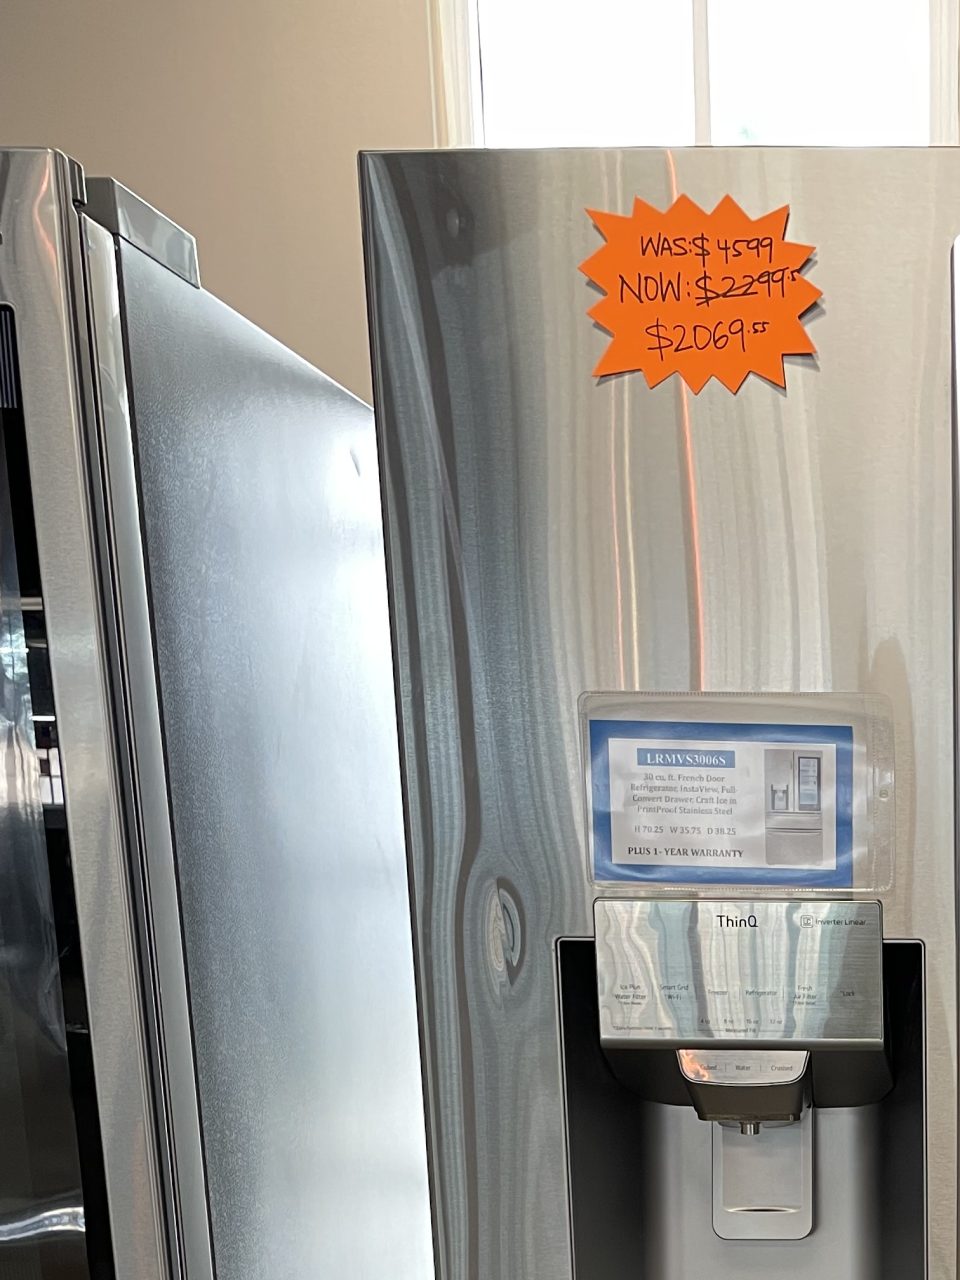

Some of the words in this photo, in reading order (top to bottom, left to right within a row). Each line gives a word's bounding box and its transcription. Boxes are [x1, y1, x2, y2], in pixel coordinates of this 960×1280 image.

[647, 752, 726, 766] LRMVS3006S
[678, 774, 704, 782] French
[706, 775, 725, 783] Door
[632, 794, 662, 803] Convert
[696, 796, 715, 804] Craft
[716, 796, 728, 805] Ice
[679, 806, 713, 815] Stainless
[714, 807, 733, 815] Steel
[669, 826, 678, 834] W
[707, 827, 713, 835] D
[628, 846, 651, 855] PLUS
[664, 848, 689, 856] YEAR
[690, 848, 744, 858] WARRANTY
[716, 915, 759, 928] ThinQ
[815, 918, 843, 926] Inverter
[845, 918, 867, 926] Linear
